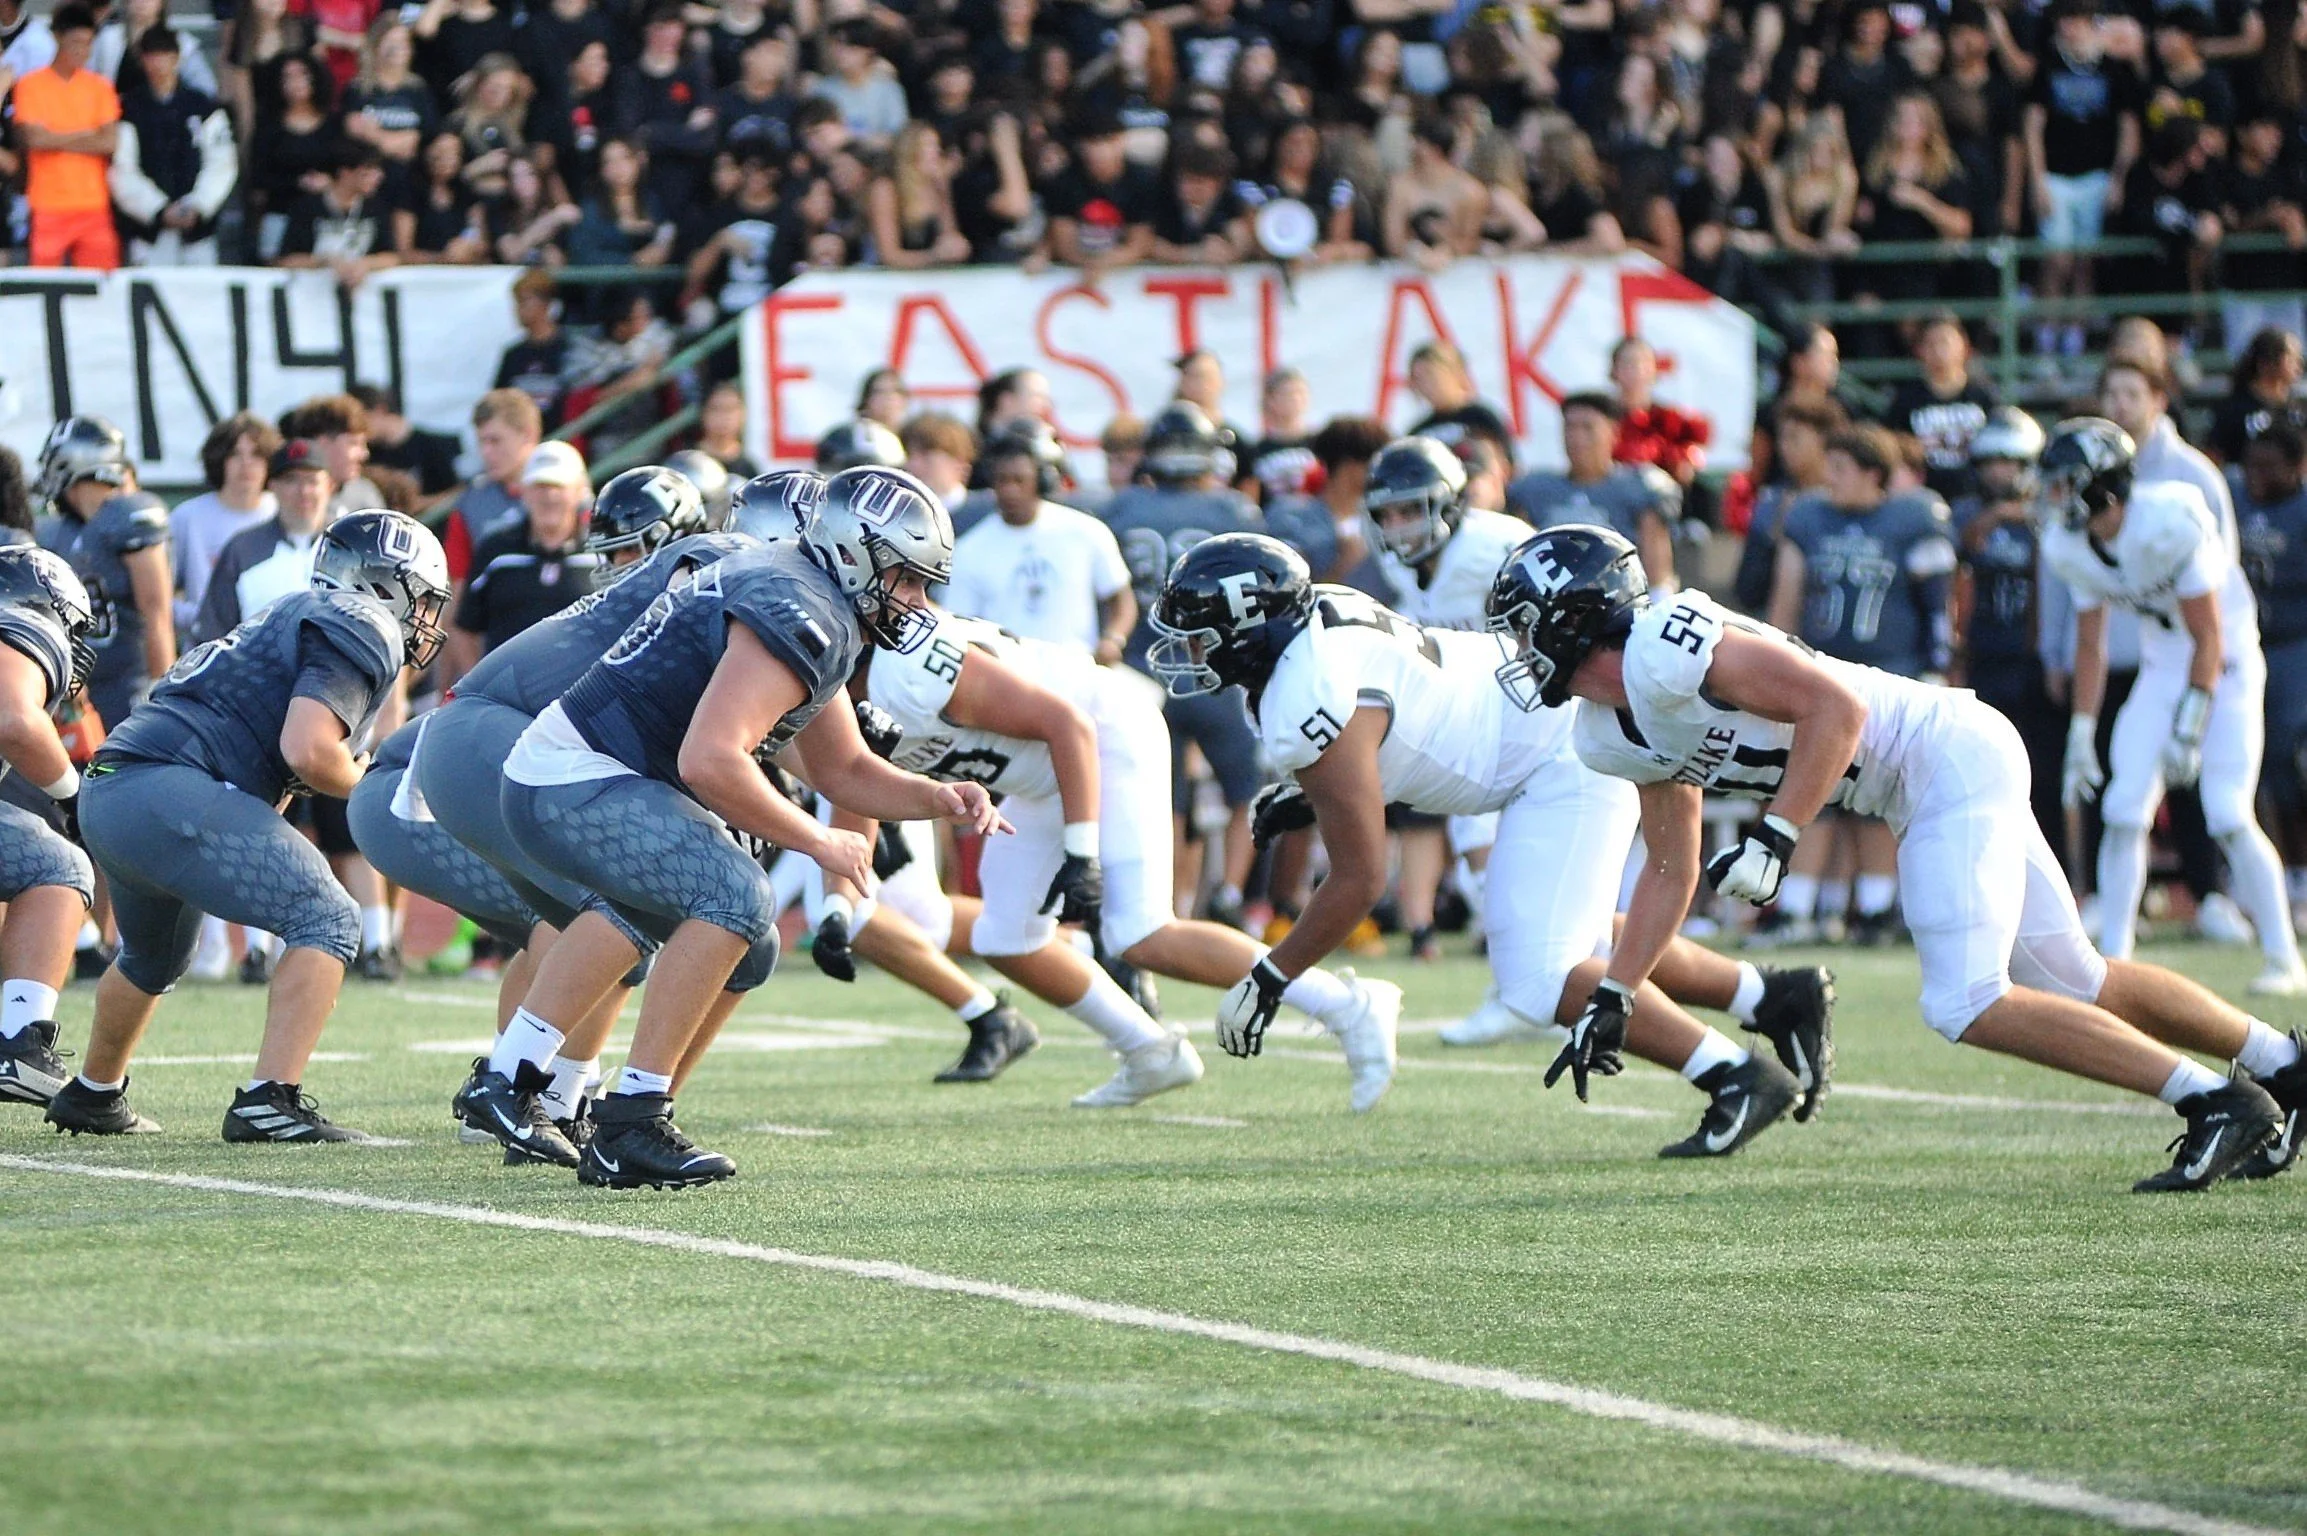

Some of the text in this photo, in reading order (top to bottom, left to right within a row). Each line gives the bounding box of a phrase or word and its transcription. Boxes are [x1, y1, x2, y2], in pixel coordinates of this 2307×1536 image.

[850, 472, 913, 527] U
[1519, 539, 1574, 598] E
[1218, 571, 1267, 631] E
[1659, 604, 1713, 656] 54
[923, 638, 965, 684] 50
[1299, 706, 1342, 752] 51
[1671, 726, 1737, 788] TLAKE
